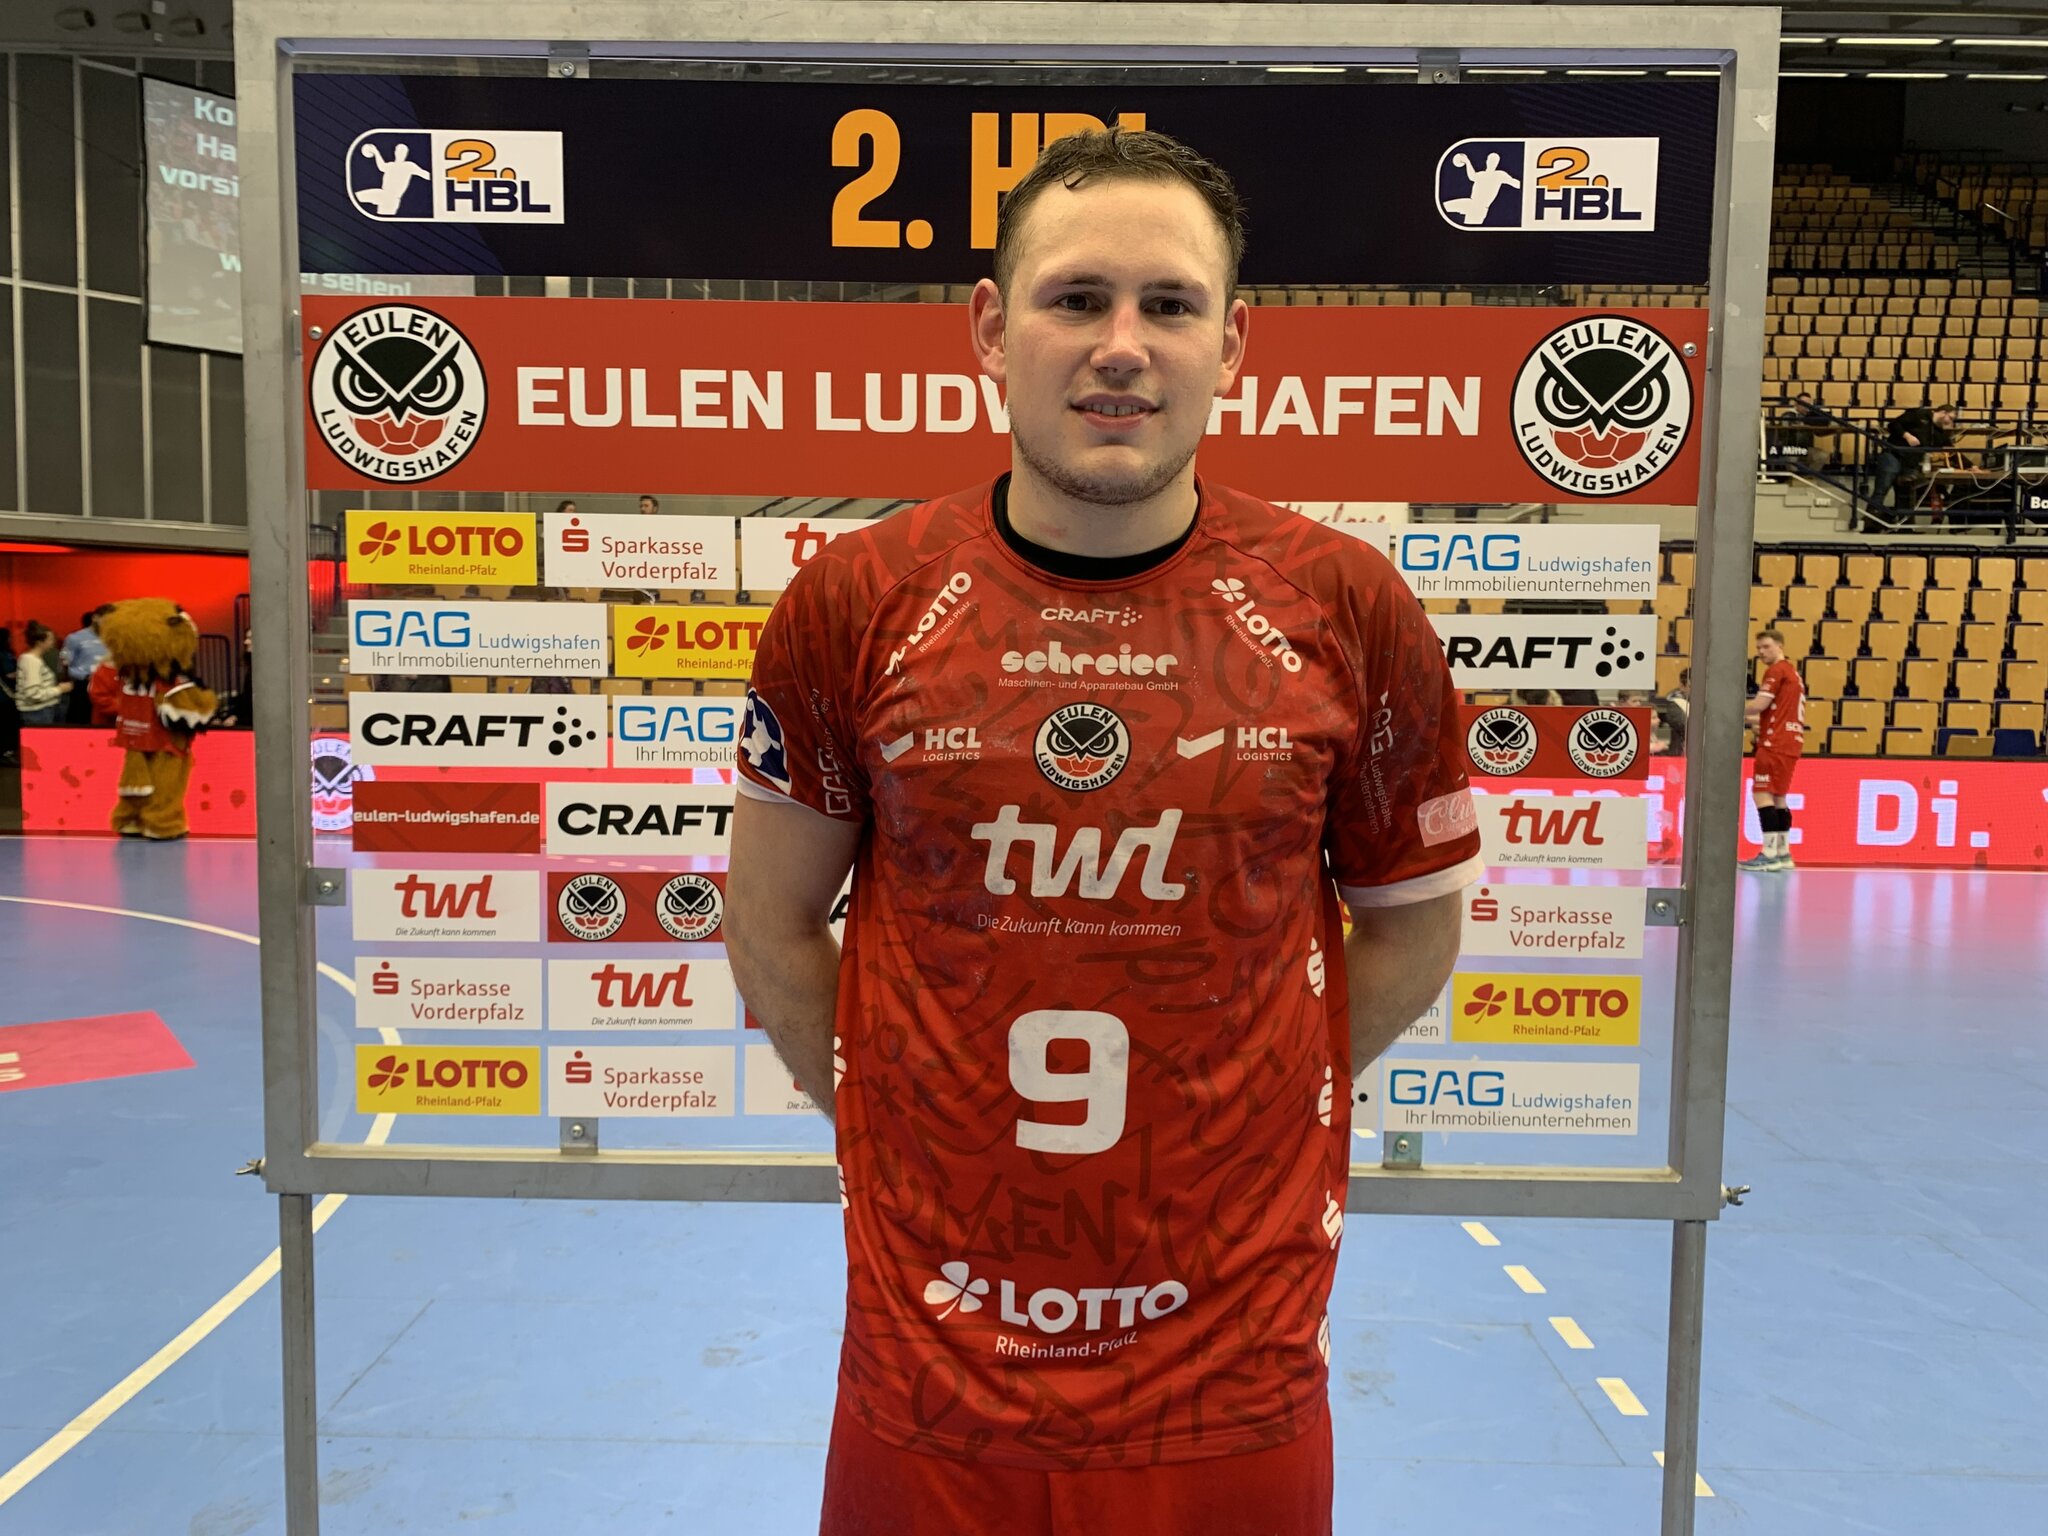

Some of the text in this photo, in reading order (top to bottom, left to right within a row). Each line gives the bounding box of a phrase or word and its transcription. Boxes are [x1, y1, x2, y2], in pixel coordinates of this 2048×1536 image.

[444, 139, 517, 182] 2.
[1536, 146, 1609, 190] 2.
[831, 109, 933, 249] 2.
[446, 179, 552, 214] HBL
[1535, 187, 1642, 221] HBL
[343, 310, 451, 349] EULEN
[1550, 325, 1663, 362] EULEN
[517, 367, 784, 430] EULEN
[320, 408, 478, 478] LUDWIGSHAFEN
[1520, 422, 1683, 492] LUDWIGSHAFEN
[408, 525, 523, 557] LOTTO
[601, 536, 703, 557] Sparkasse
[1401, 534, 1651, 576] GAG Ludwigshafen
[408, 564, 497, 576] Rheinland-Pfalz
[601, 561, 717, 583] Vorderpfalz
[1417, 576, 1651, 593] Ihr Immobilienunternehmen
[907, 571, 972, 646] LOTTO
[1040, 607, 1121, 624] CRAFT
[355, 610, 600, 653] GAG Ludwigshafen
[677, 620, 763, 651] LOTT
[919, 600, 971, 654] Rheinland-Pfalz
[1235, 600, 1302, 673] LOTTO
[1224, 614, 1274, 670] Rheinland-Pfalz
[1440, 636, 1592, 669] RAFT
[372, 652, 601, 670] Ihr Immobilienunternehmen
[677, 658, 753, 670] Rheinland-Pfa
[1001, 640, 1178, 676] schreier
[998, 677, 1179, 692] Maschinen- und Apparatebau GmbH
[619, 705, 734, 742] GAG
[1057, 705, 1113, 724] EULEN
[1484, 710, 1525, 724] EULEN
[1585, 712, 1626, 726] EULEN
[361, 712, 544, 747] CRAFT
[924, 727, 982, 750] HCL
[1237, 727, 1294, 749] HCL
[636, 746, 658, 761] Ihr
[922, 752, 980, 762] LOGISTICS
[1236, 752, 1293, 761] LOGISTICS
[1470, 747, 1534, 775] LUDWIGSHAFEN
[1571, 748, 1634, 776] LUDWIGSHAFEN
[1038, 752, 1125, 789] LUDWIGSHAFEN
[354, 810, 540, 826] eulen-ludwigshafen.de
[557, 802, 734, 836] CRAFT
[1499, 800, 1604, 845] twl
[1856, 778, 1990, 848] Di.
[970, 804, 1186, 900] twl
[1499, 853, 1603, 864] Die Zukunft kann kommen
[394, 874, 497, 918] twl
[572, 877, 613, 890] EULEN
[670, 877, 711, 890] EULEN
[561, 912, 623, 939] LUDWIGSHAFEN
[659, 912, 721, 939] LUDWIGSHAFEN
[978, 914, 1181, 936] Die Zukunft kann kommen
[1510, 906, 1613, 926] Sparkasse
[396, 927, 496, 937] Die Zukunft kann kommen
[1510, 930, 1625, 952] Vorderpfalz
[411, 979, 510, 999] Sparkasse
[591, 964, 693, 1007] twl
[411, 1003, 524, 1024] Vorderpfalz
[1514, 987, 1629, 1018] LOTTO
[592, 1017, 692, 1027] Die Zukunft kann kommen
[1513, 1024, 1601, 1037] Rheinland-Pfalz
[416, 1059, 528, 1089] LOTTO
[604, 1067, 703, 1086] Sparkasse
[1008, 1009, 1130, 1154] 9
[416, 1096, 502, 1107] Rheinland-Pfalz
[604, 1092, 716, 1111] Vorderpfalz
[1390, 1069, 1632, 1113] GAG Ludwigshafen
[1405, 1109, 1631, 1129] Ihr Immobilienunternehmen
[1000, 1279, 1189, 1334] LOTTO
[995, 1331, 1138, 1358] Rheinland-Pfalz
